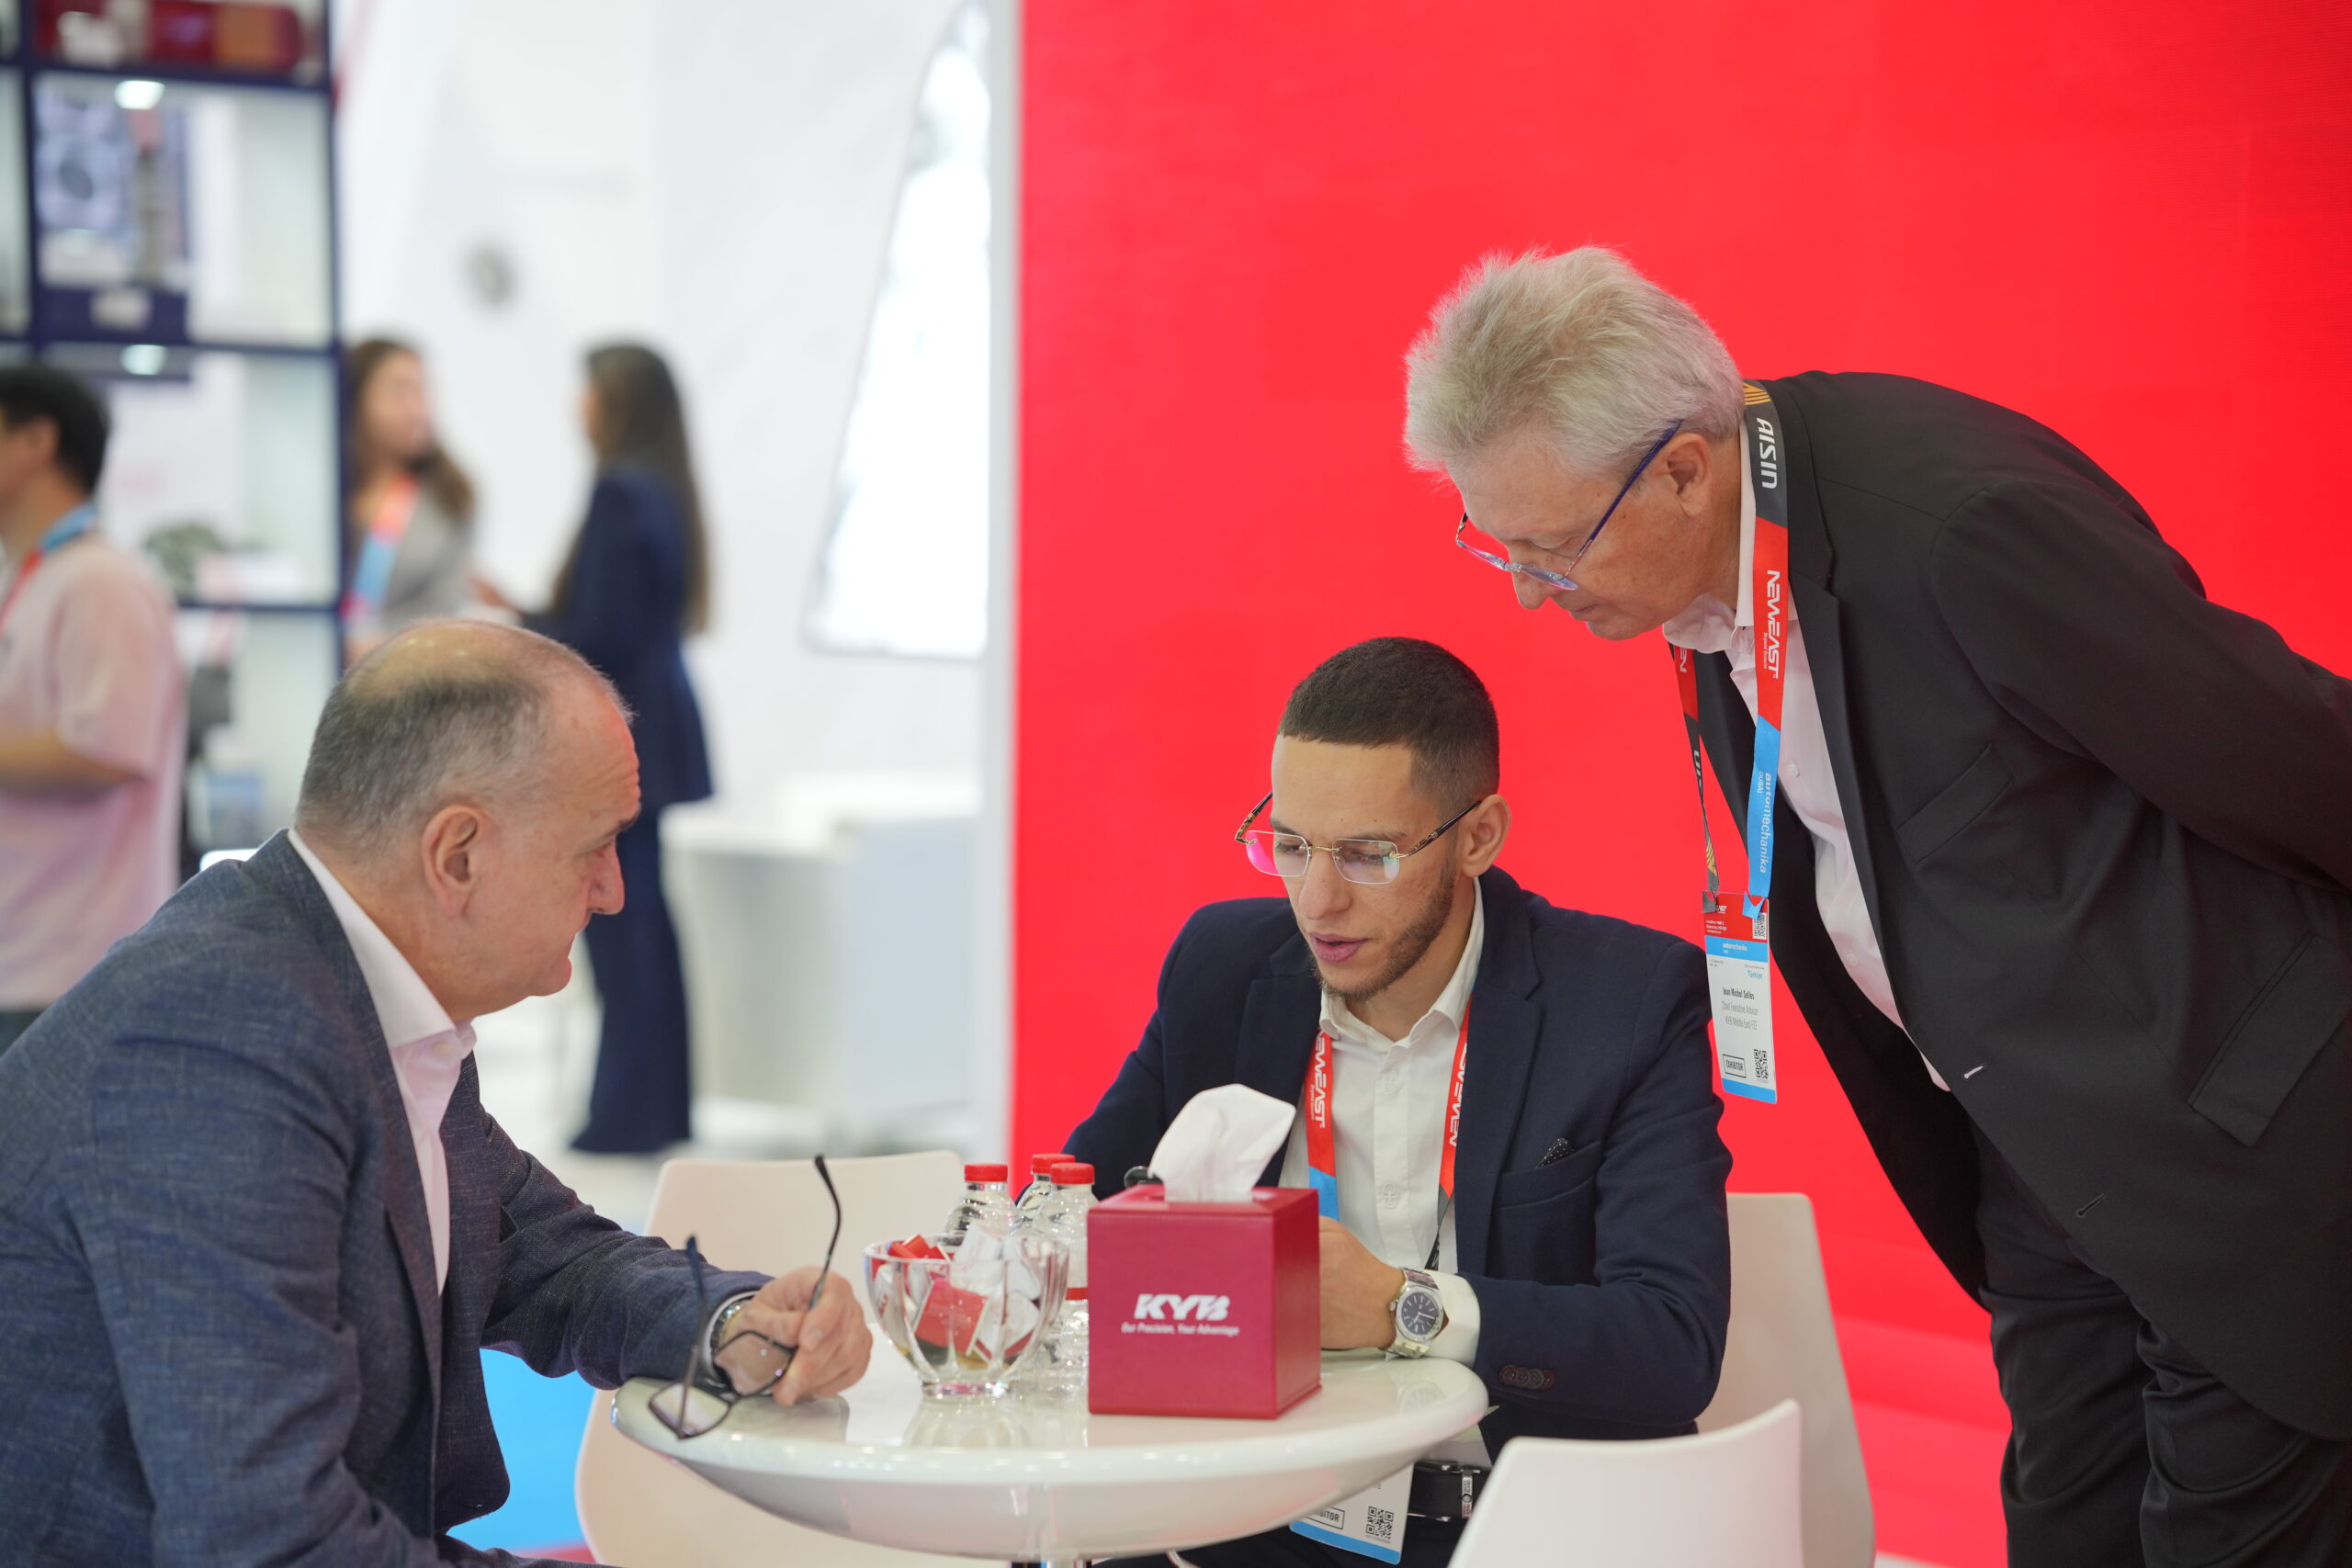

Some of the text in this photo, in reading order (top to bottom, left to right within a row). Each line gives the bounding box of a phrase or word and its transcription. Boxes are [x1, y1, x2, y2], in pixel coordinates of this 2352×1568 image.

[1756, 417, 1778, 490] AISIN
[1767, 570, 1781, 679] NEWEAST
[1759, 772, 1772, 874] automechanika
[1133, 1293, 1231, 1321] KYB
